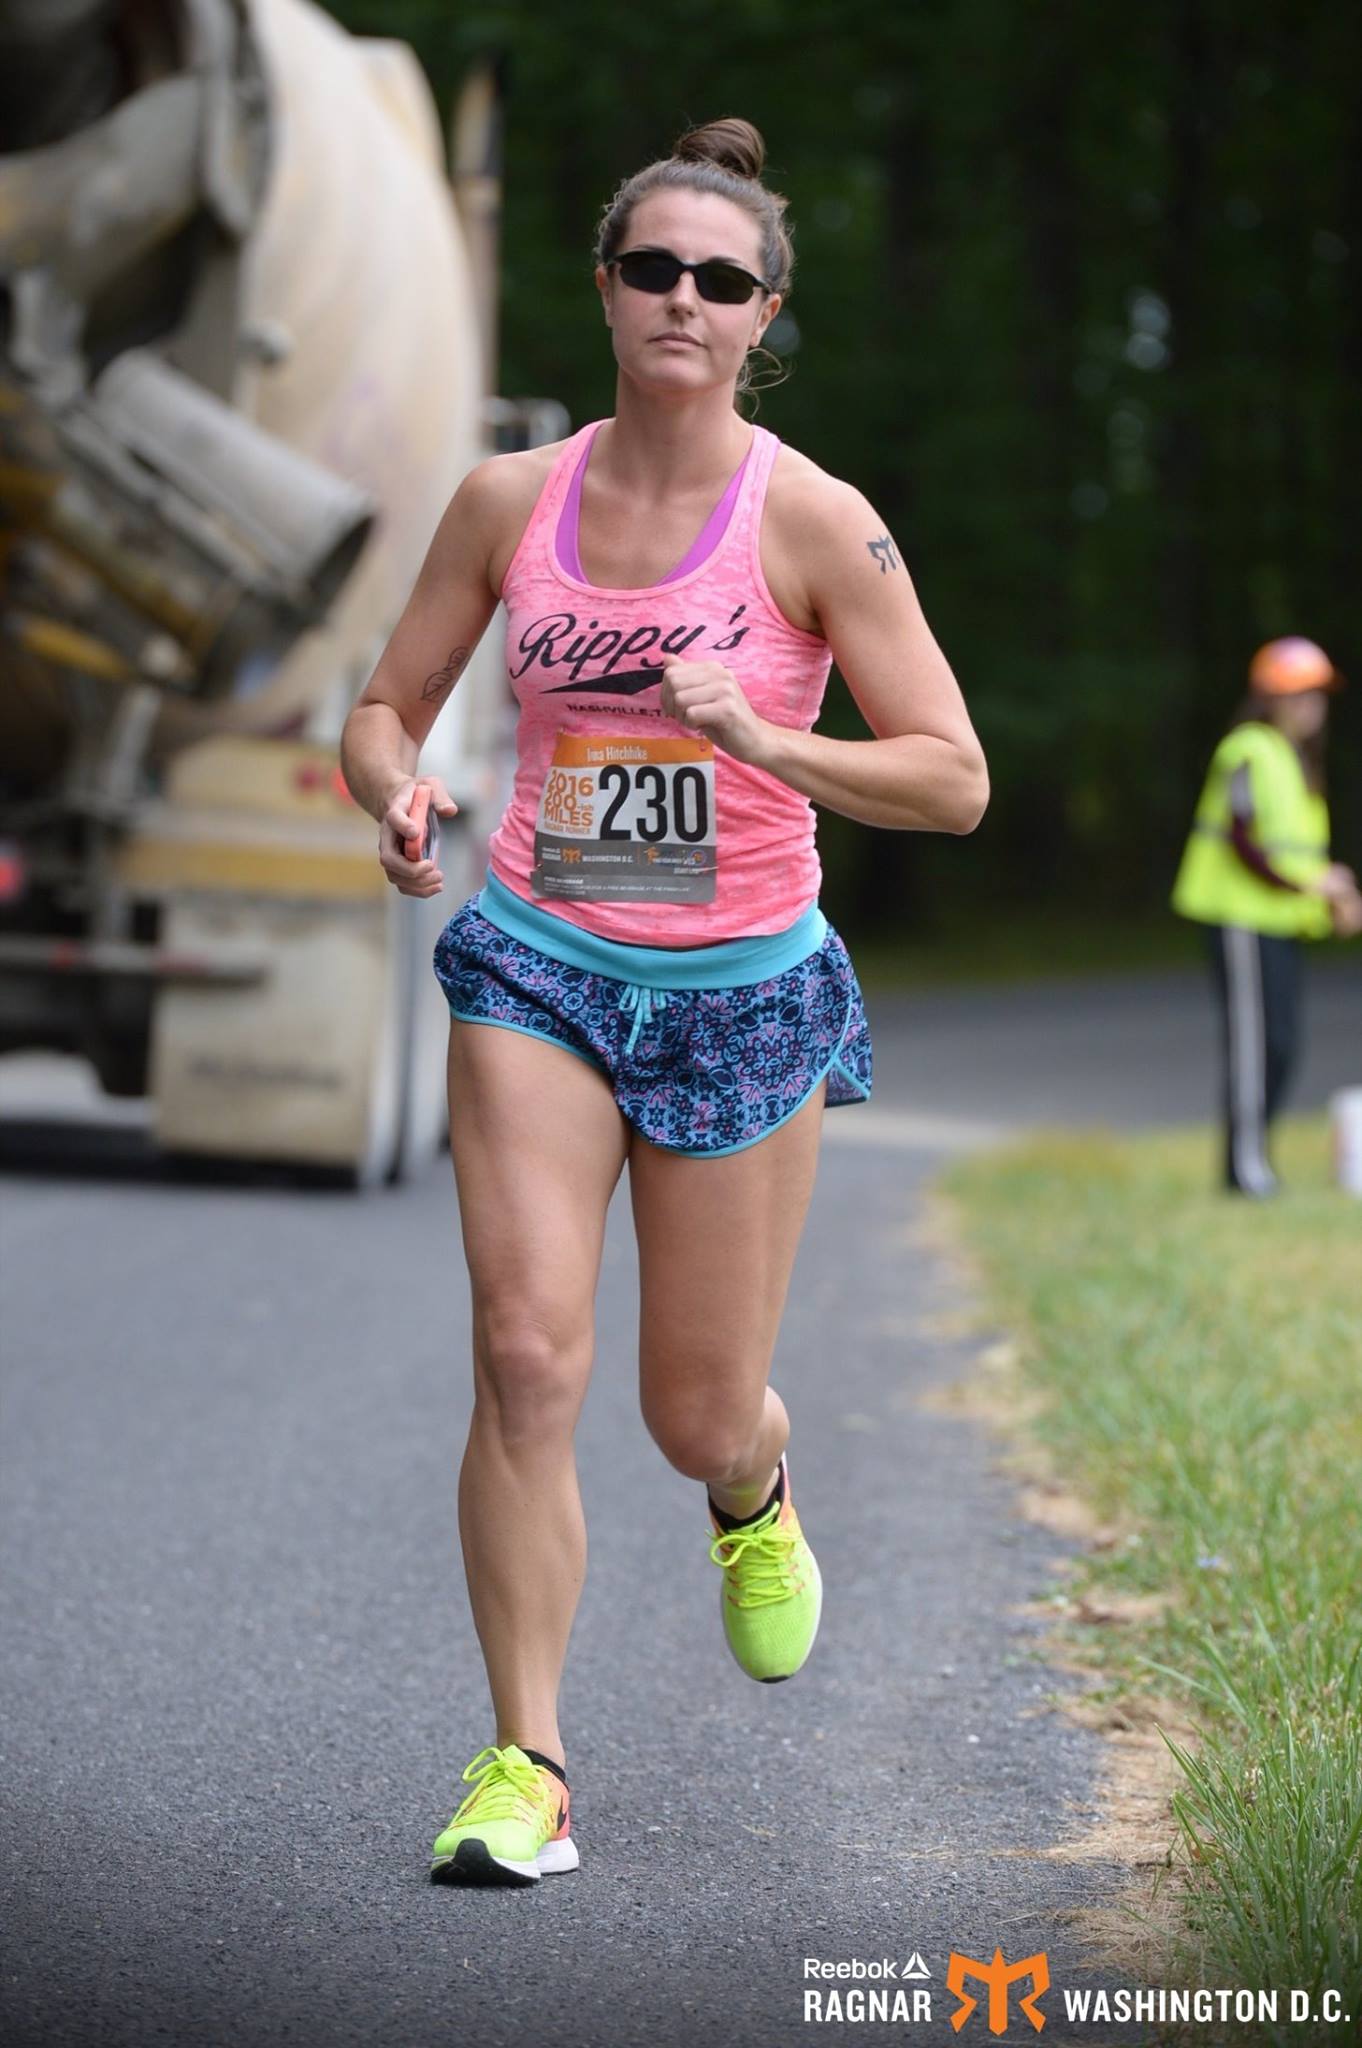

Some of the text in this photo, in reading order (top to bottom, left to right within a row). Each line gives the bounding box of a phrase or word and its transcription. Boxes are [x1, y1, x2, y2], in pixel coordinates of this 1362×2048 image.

[509, 605, 750, 680] Rippy's
[547, 769, 594, 797] 2016
[598, 764, 708, 843] 230
[544, 803, 593, 827] MILES
